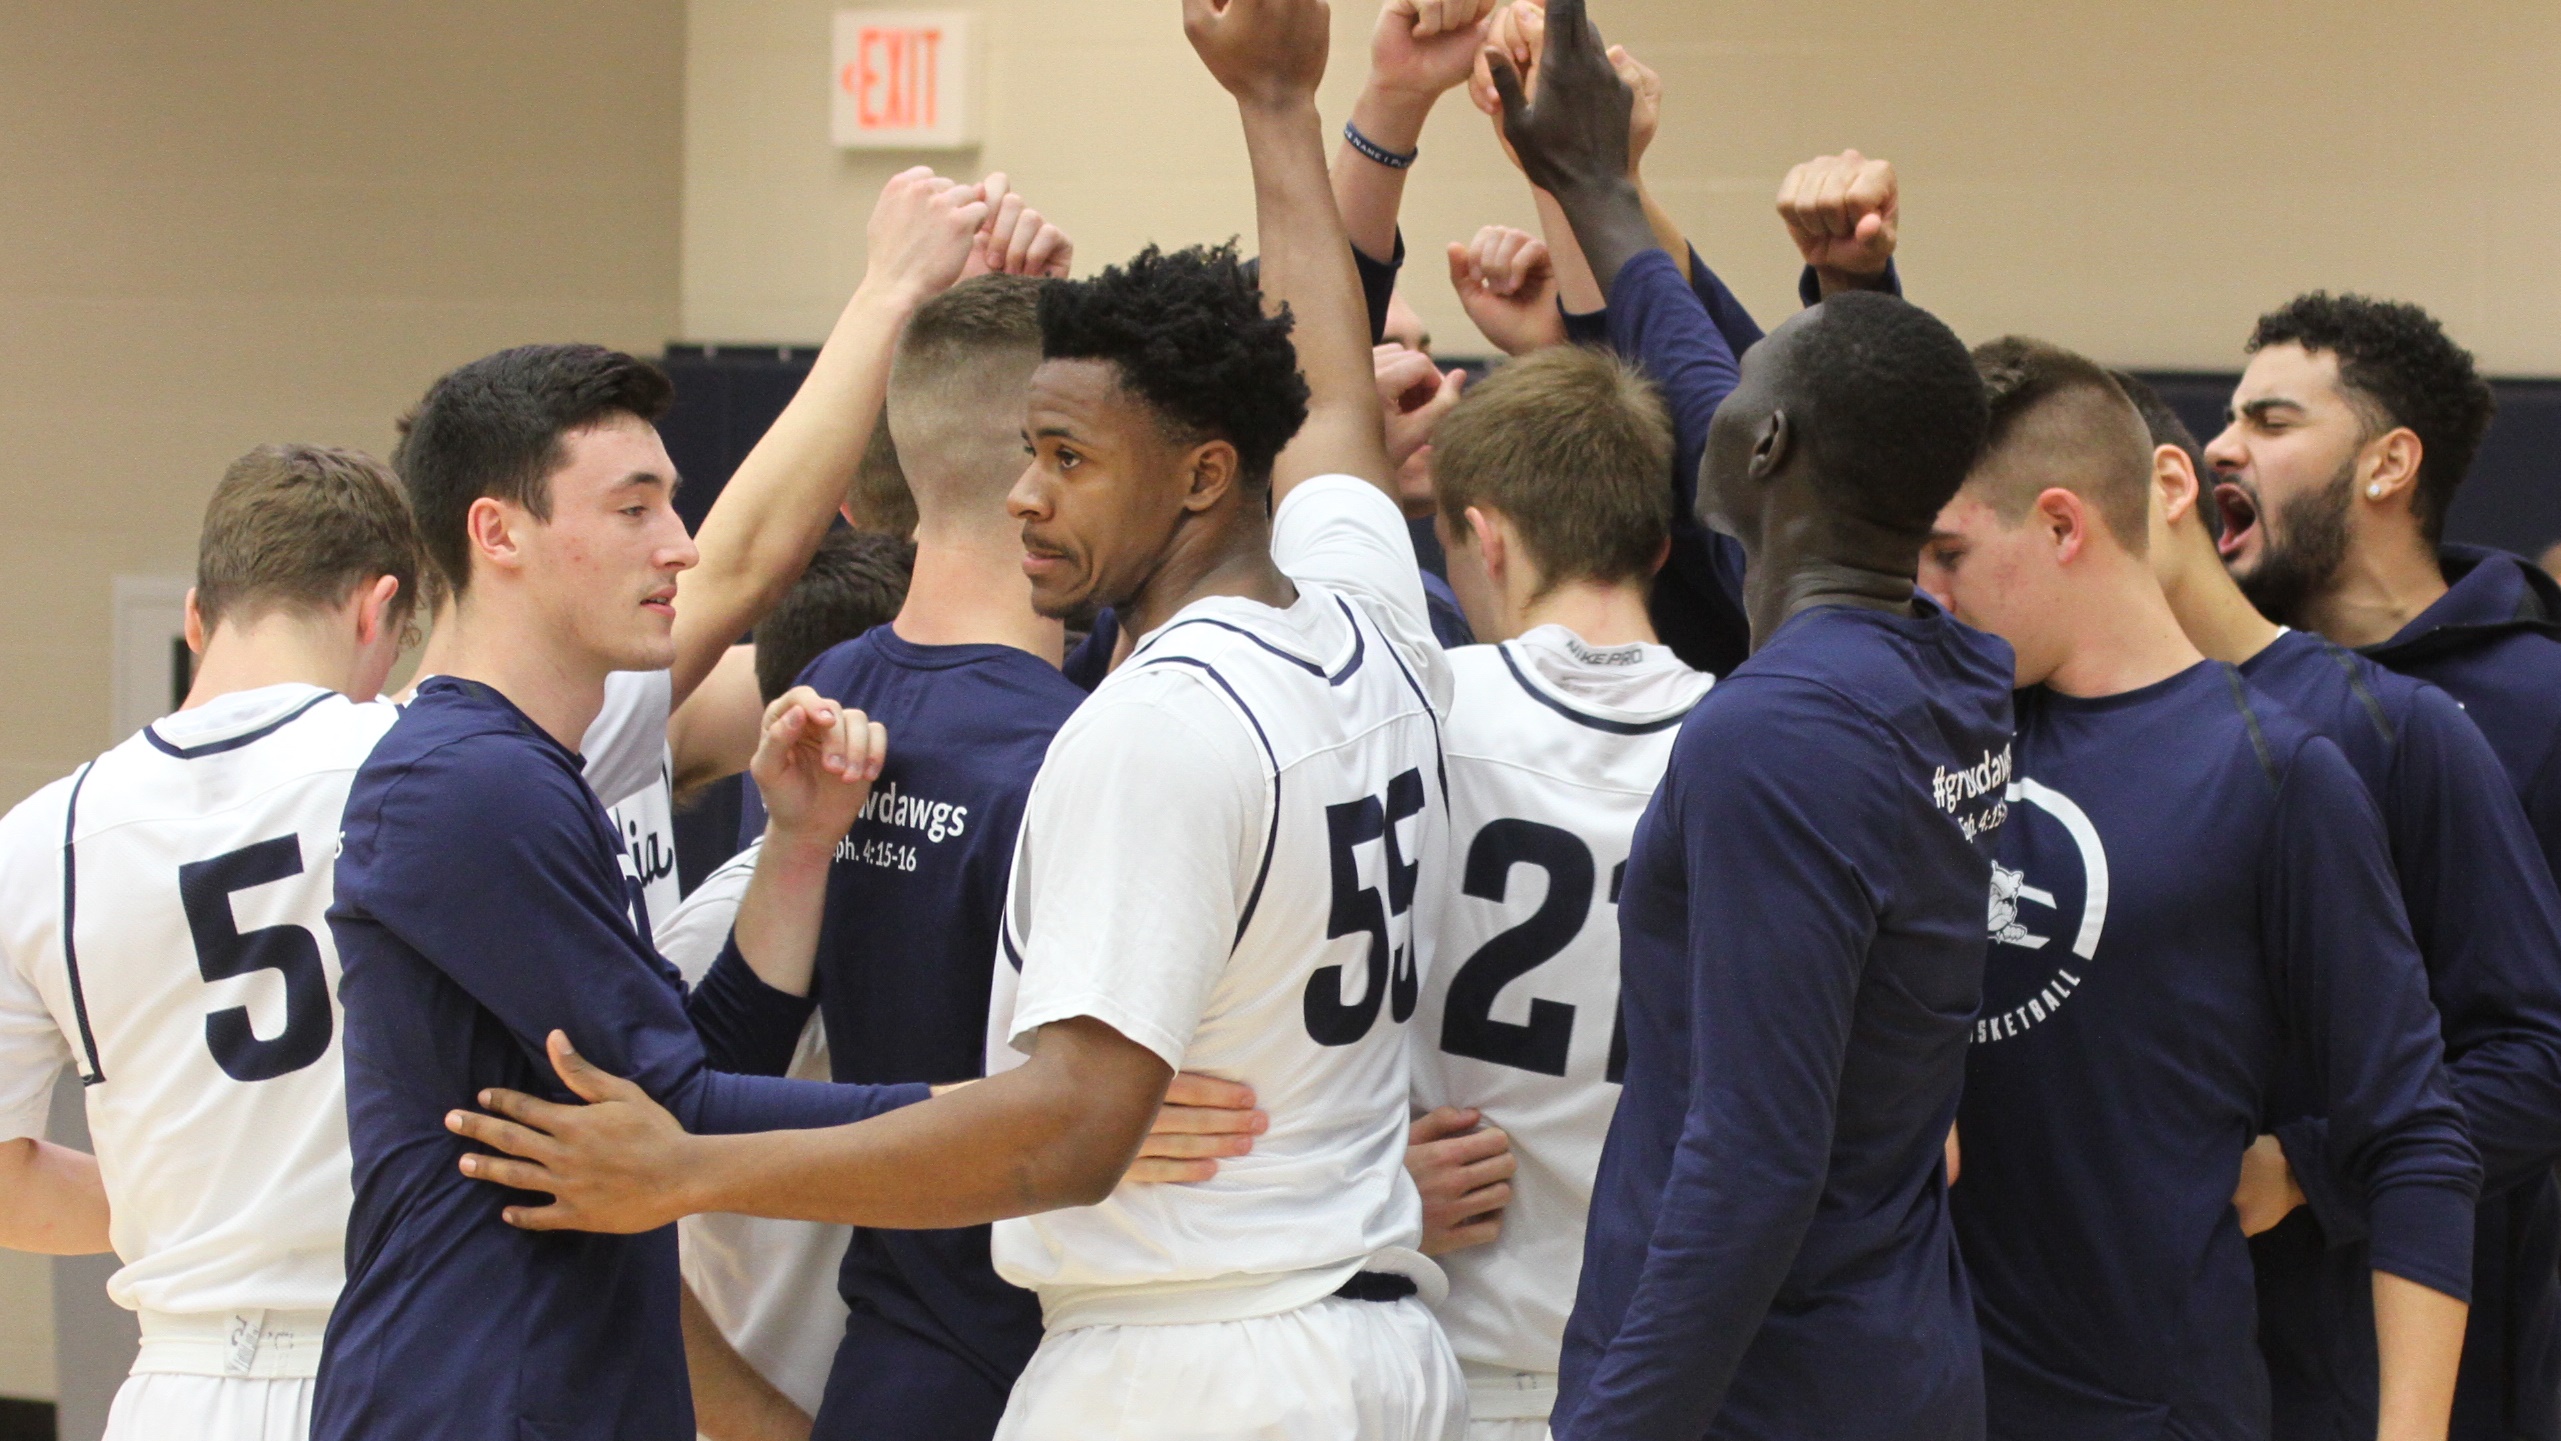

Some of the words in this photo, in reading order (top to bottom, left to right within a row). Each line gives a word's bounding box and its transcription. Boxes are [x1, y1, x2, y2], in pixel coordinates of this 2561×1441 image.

[858, 26, 941, 129] EXIT
[1566, 640, 1607, 665] NIKE
[1607, 648, 1643, 667] PRO
[858, 781, 968, 843] wdawgs
[833, 834, 859, 864] ph.
[863, 839, 917, 873] 4:15-16
[1303, 767, 1425, 1047] 55
[178, 832, 333, 1082] 5
[1970, 968, 2081, 1044] SKETBALL
